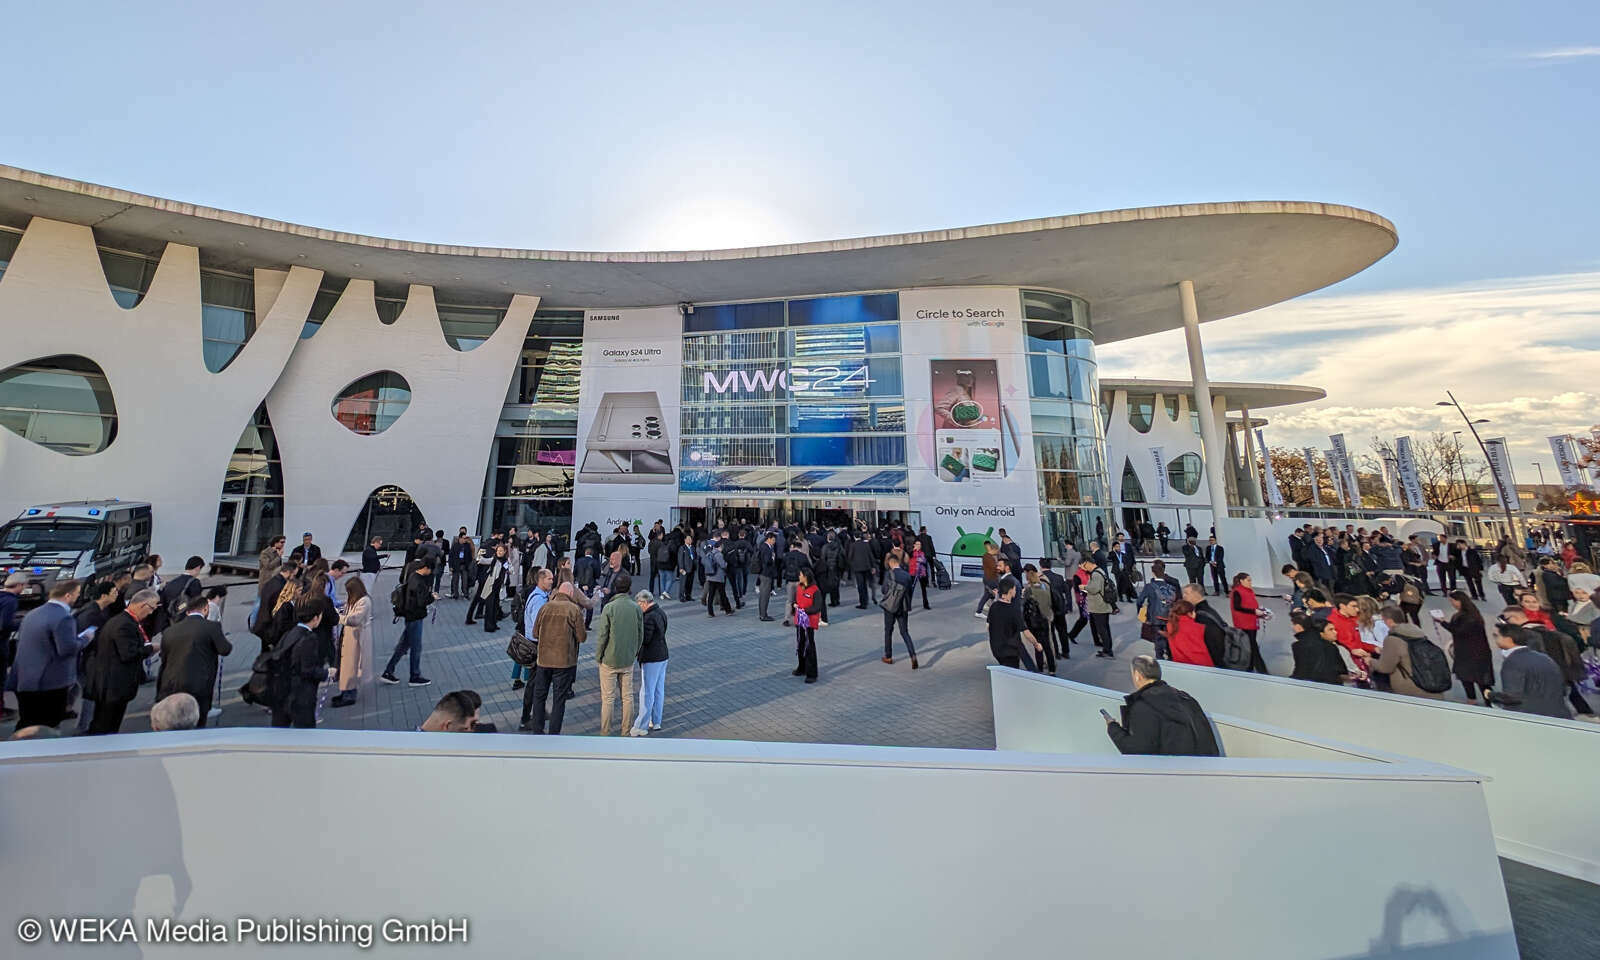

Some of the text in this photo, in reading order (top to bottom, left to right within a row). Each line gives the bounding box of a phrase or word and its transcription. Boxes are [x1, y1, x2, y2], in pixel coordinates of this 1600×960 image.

[916, 308, 1005, 319] Circle to Search
[603, 349, 630, 357] Galaxy
[935, 506, 1015, 517] Only on Android
